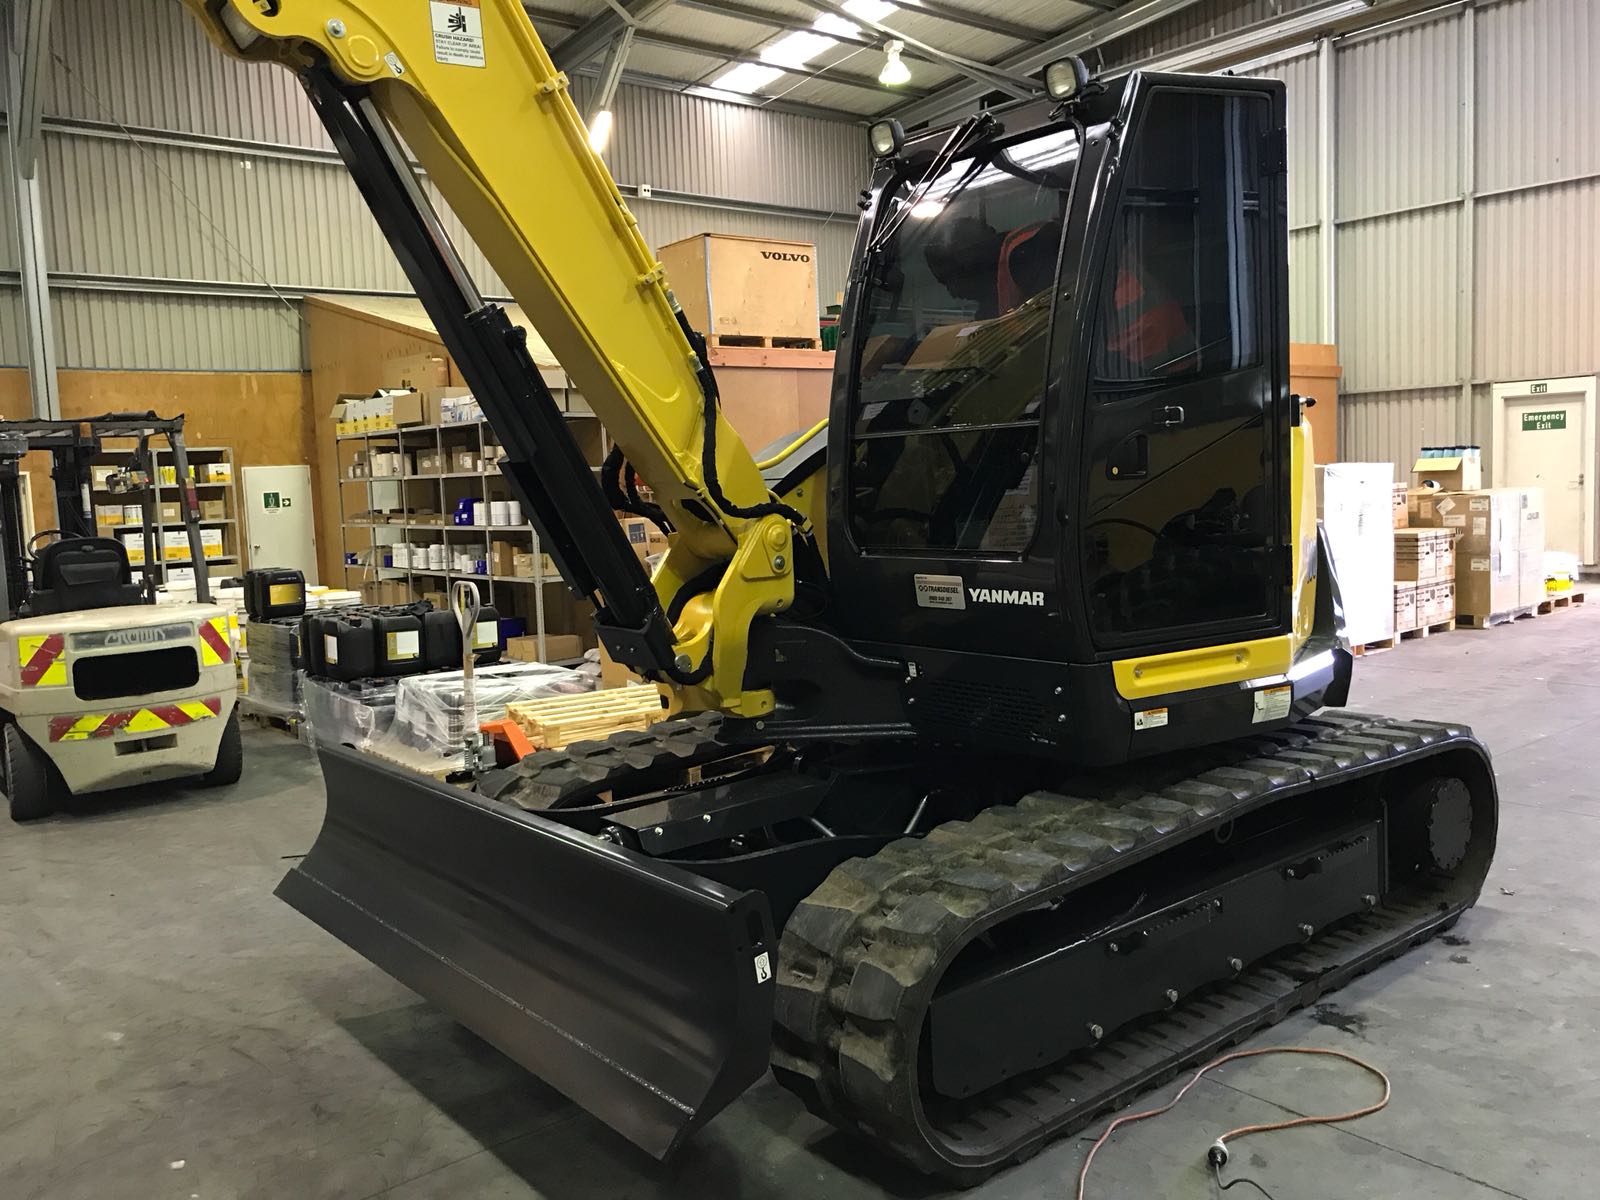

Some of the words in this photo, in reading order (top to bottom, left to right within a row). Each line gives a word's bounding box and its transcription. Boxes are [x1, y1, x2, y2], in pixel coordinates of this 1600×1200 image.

[760, 251, 810, 263] VOLVO
[1531, 384, 1547, 393] Exit
[1524, 413, 1564, 422] Emergency
[1536, 422, 1552, 430] Exit
[928, 585, 959, 594] TRANSDIESEL
[968, 588, 1044, 606] YANMAR
[104, 628, 166, 646] CROWN
